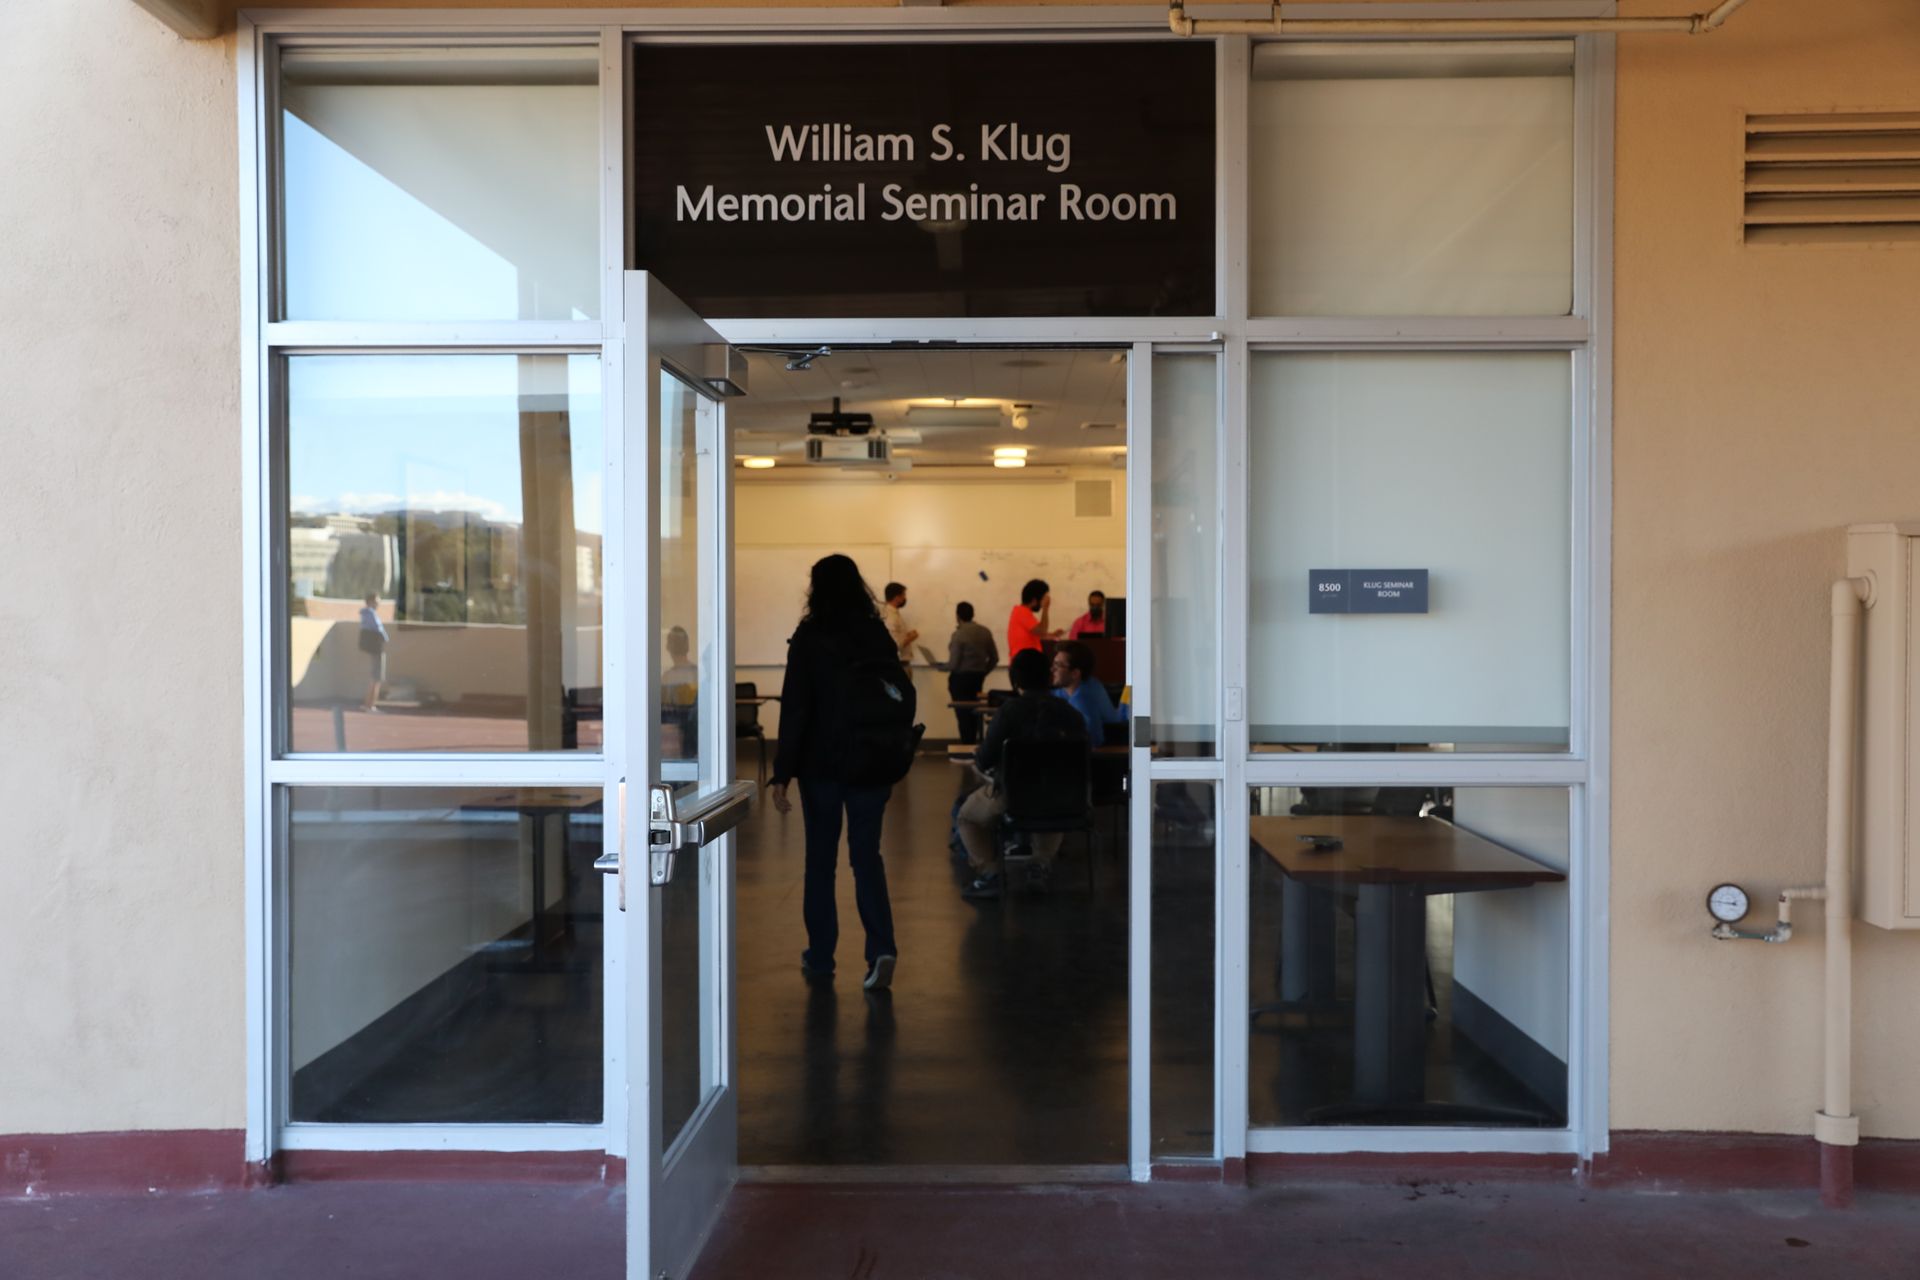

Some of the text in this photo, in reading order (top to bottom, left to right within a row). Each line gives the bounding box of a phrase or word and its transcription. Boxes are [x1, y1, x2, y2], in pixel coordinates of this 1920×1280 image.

[765, 122, 1071, 172] William S. Klug
[676, 183, 1176, 222] Memorial Seminar Room
[1377, 590, 1400, 598] ROOM
